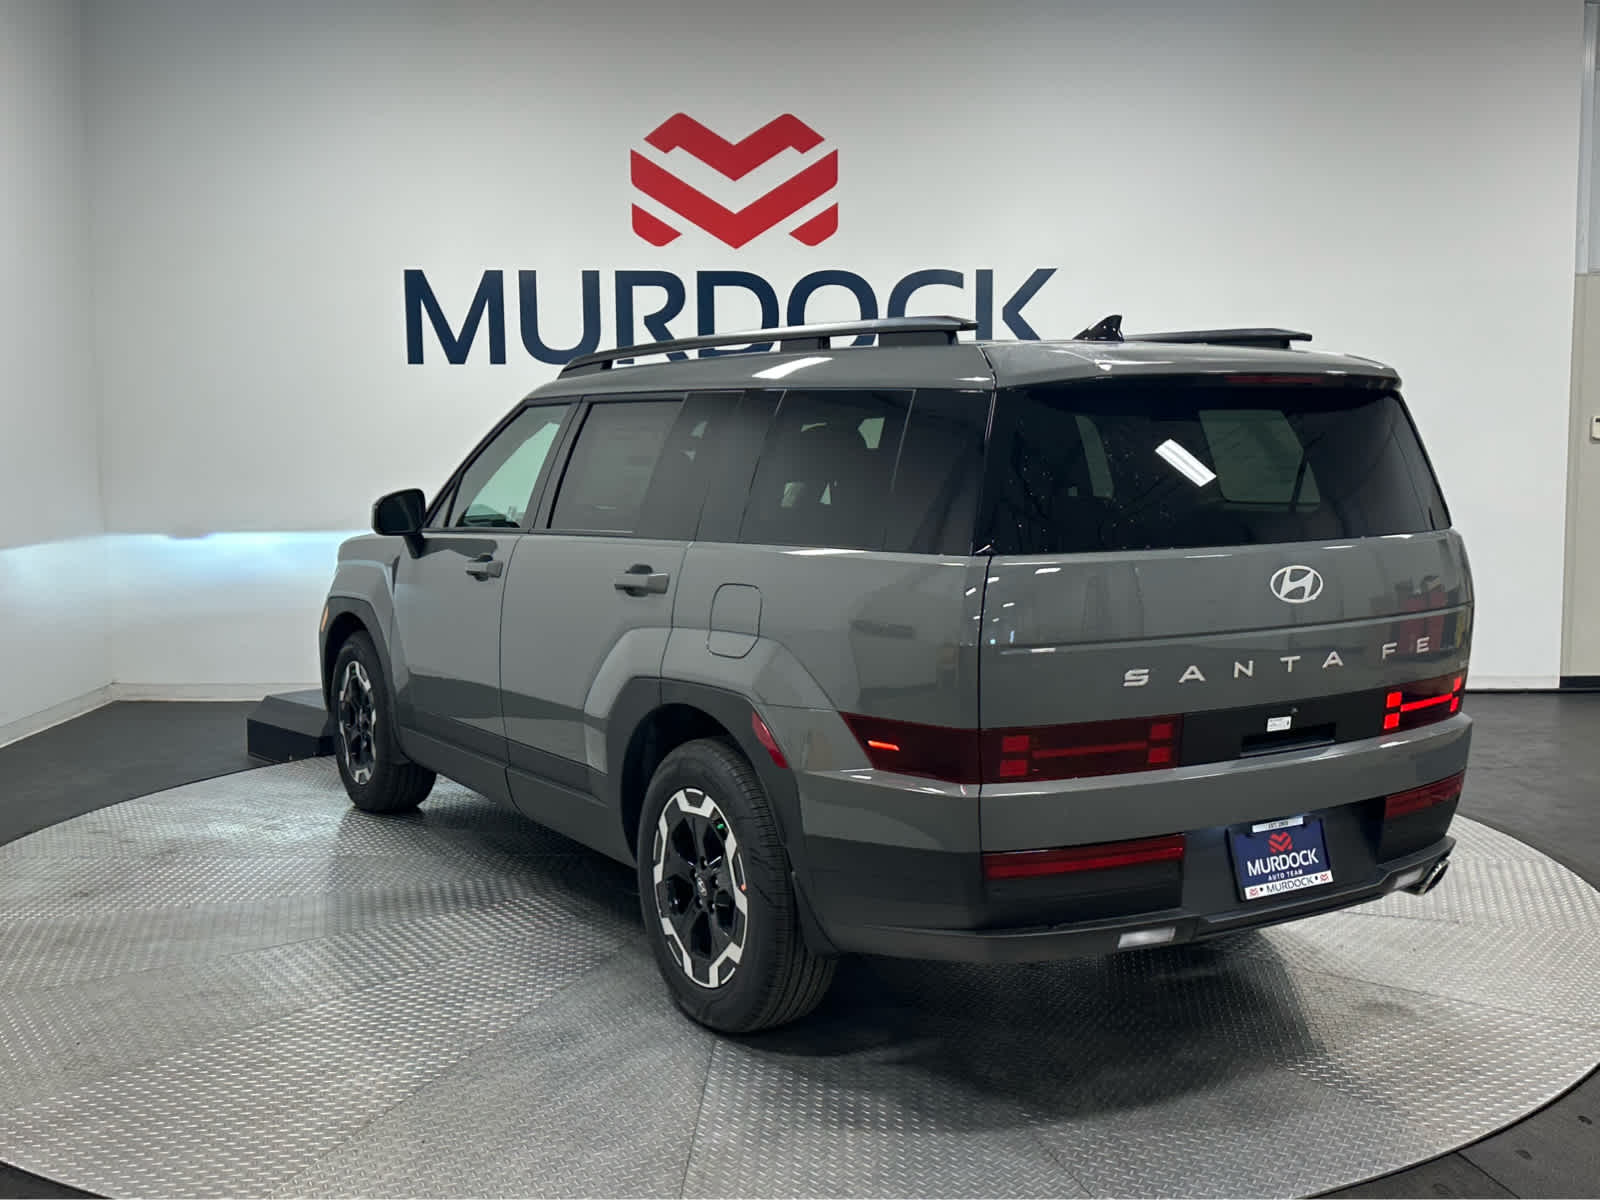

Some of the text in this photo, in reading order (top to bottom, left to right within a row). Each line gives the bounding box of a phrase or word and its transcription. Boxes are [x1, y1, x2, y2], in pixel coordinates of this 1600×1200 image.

[404, 268, 1058, 365] MURDOCK
[1123, 637, 1430, 687] SANTA FE
[1247, 848, 1319, 877] MURDOCK
[1268, 869, 1303, 881] AUTO TEAM
[1266, 876, 1314, 894] MURDOCK
